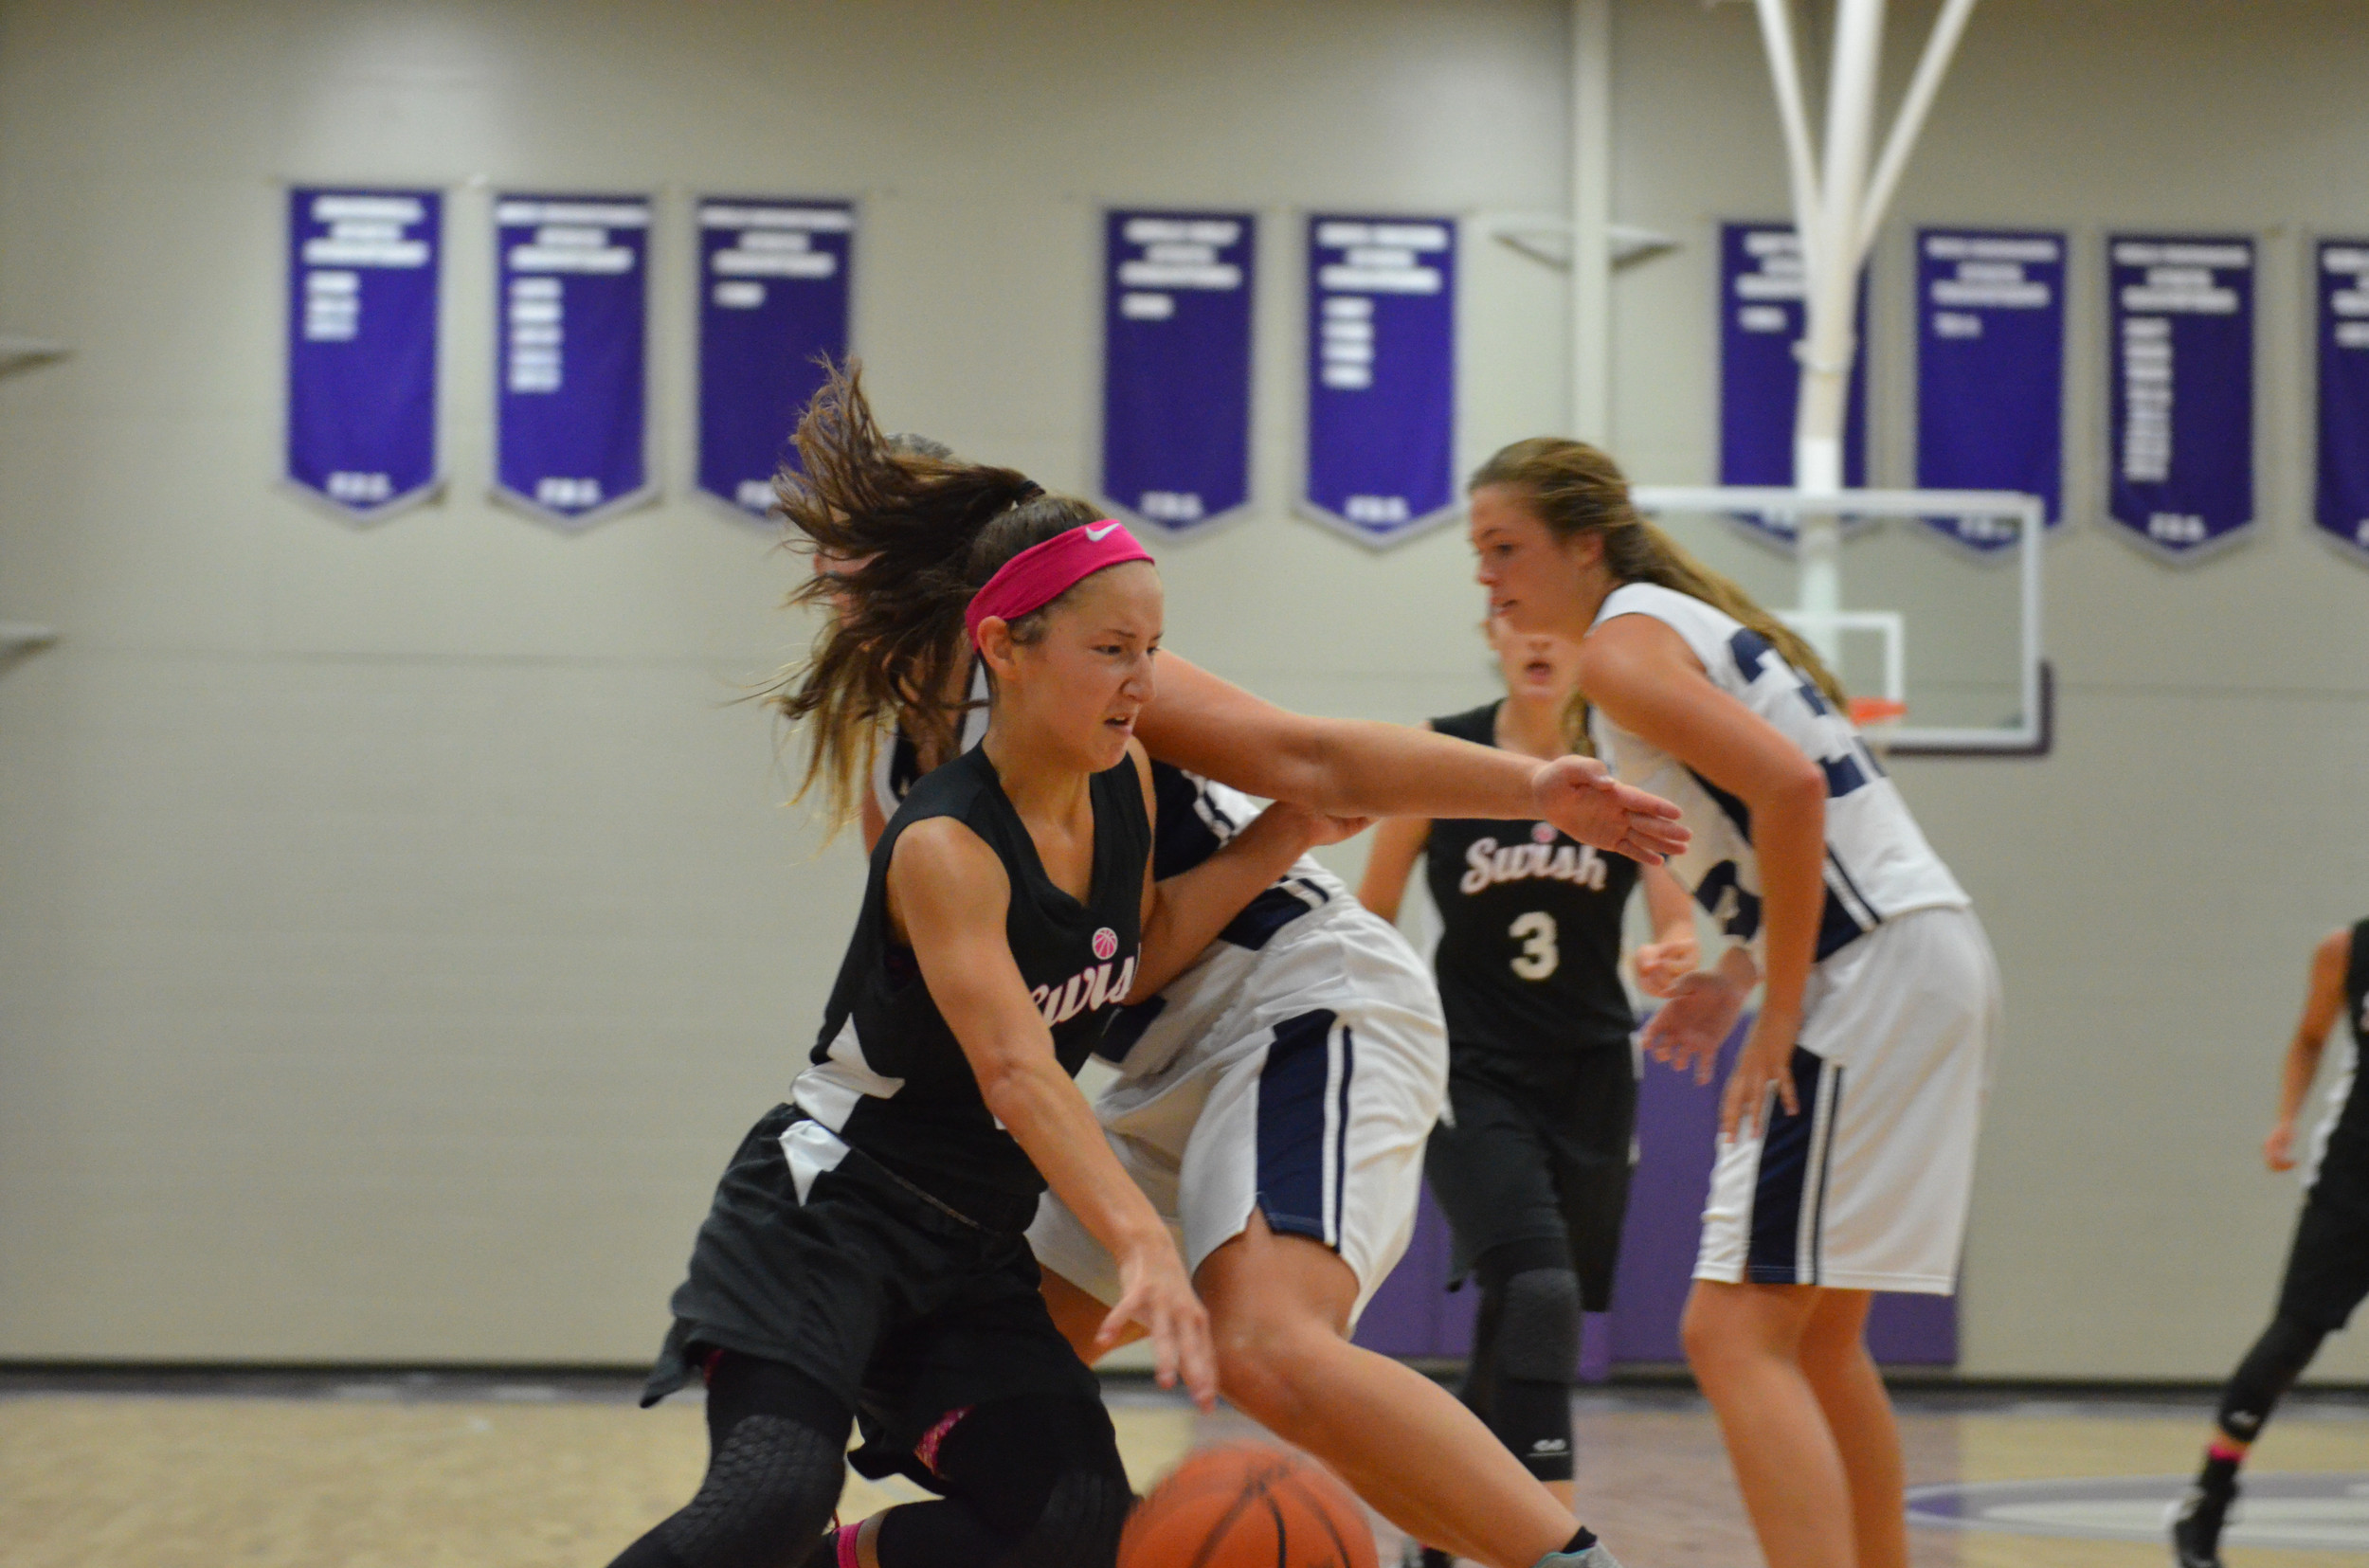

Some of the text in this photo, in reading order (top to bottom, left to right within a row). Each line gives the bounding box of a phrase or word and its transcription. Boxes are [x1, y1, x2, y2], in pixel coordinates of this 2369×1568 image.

[1459, 836, 1607, 894] Swish
[1509, 910, 1560, 982] 3
[1031, 955, 1136, 1028] wis
